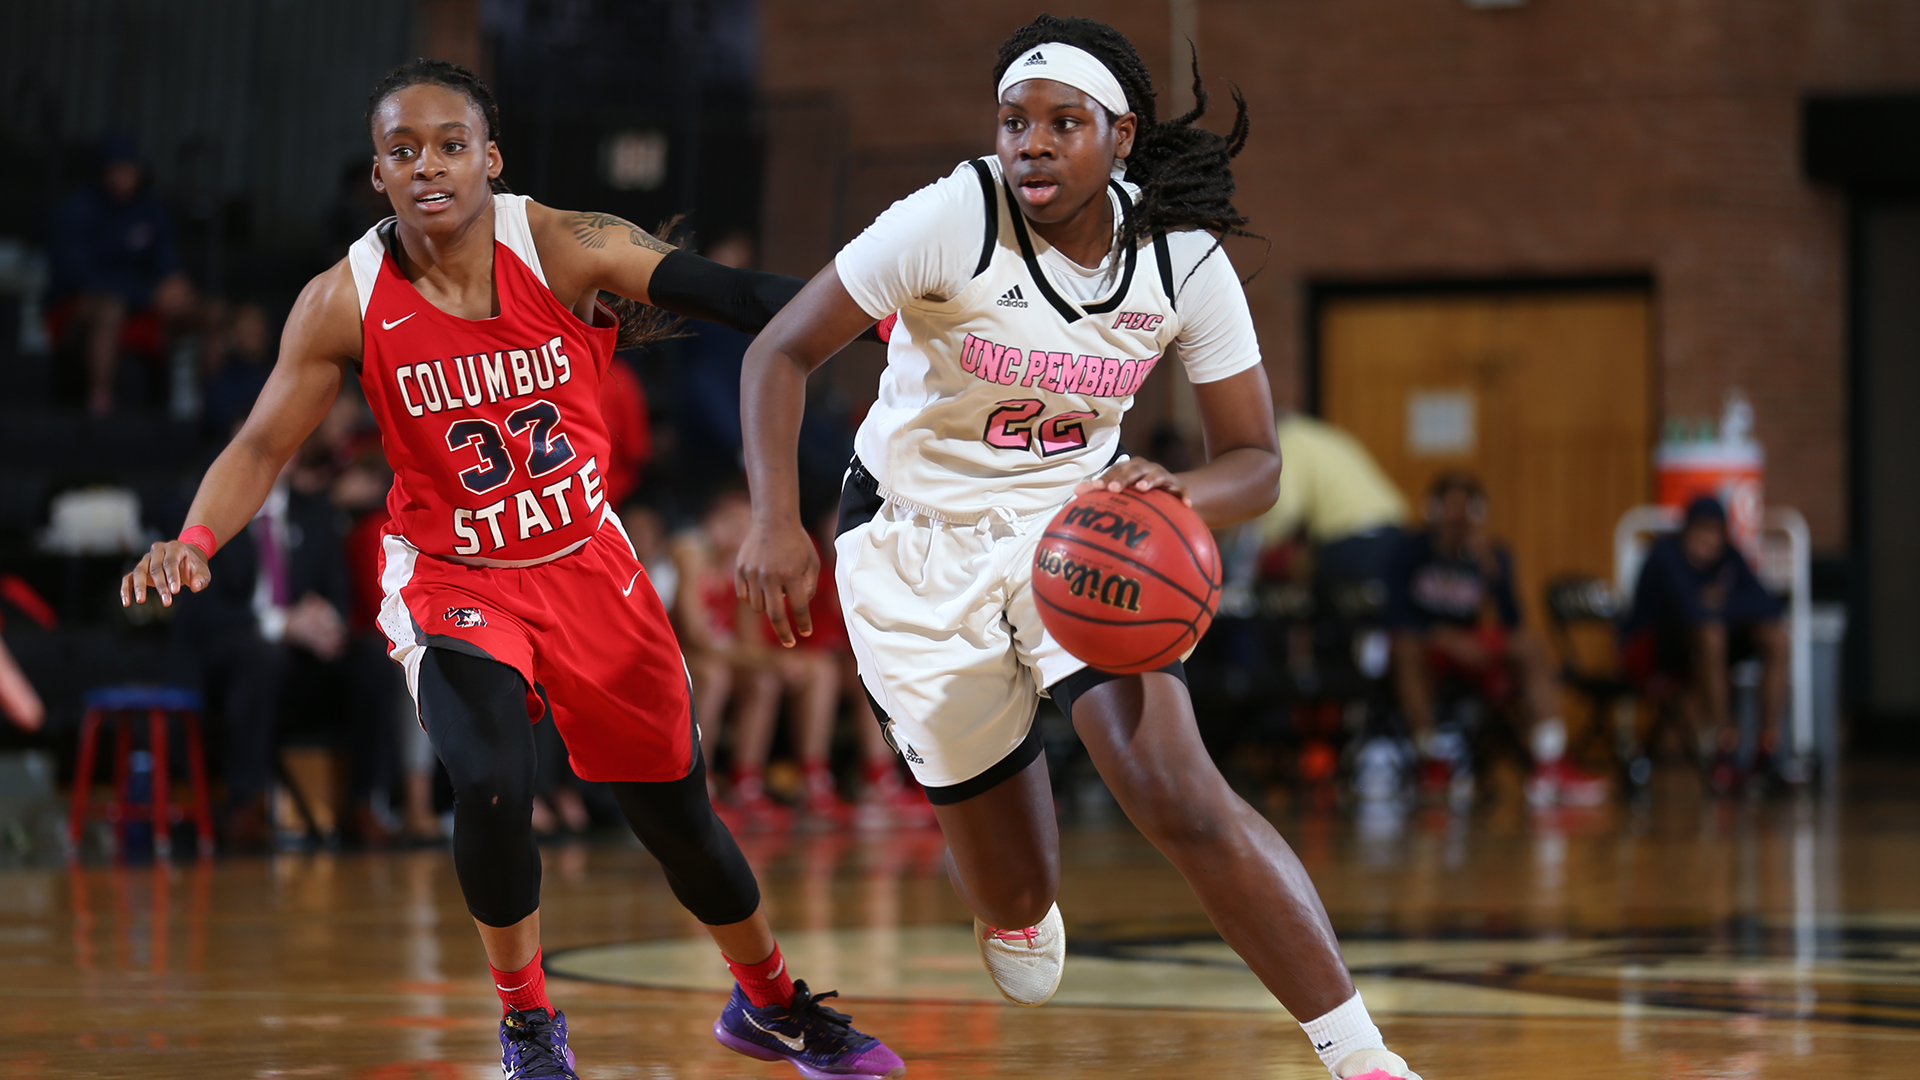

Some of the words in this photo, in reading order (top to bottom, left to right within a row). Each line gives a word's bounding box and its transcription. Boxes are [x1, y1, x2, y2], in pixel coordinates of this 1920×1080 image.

[996, 298, 1029, 309] adidas
[1111, 311, 1164, 332] PBC
[396, 335, 571, 418] COLUMBUS
[960, 333, 1022, 386] UNC
[445, 399, 576, 495] 32
[453, 455, 604, 555] STATE
[1063, 504, 1150, 550] NCAA
[1036, 547, 1141, 613] Wilson
